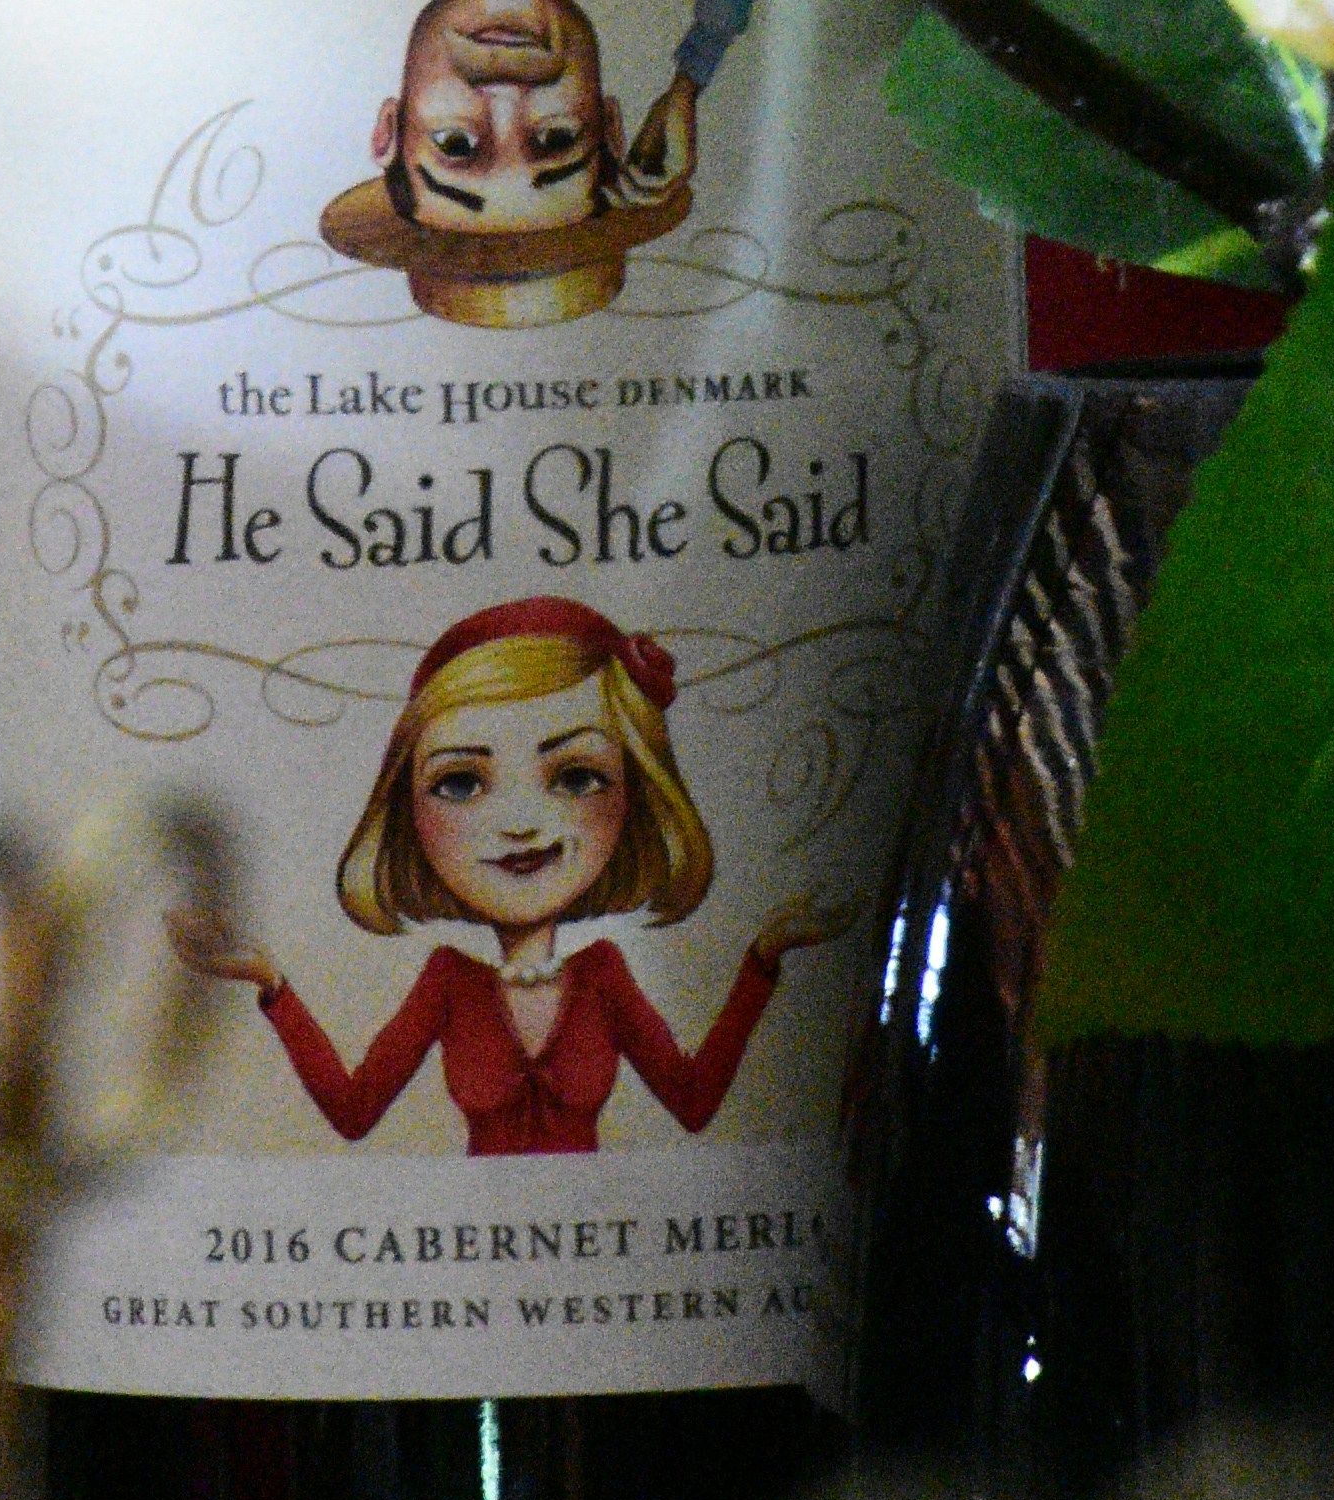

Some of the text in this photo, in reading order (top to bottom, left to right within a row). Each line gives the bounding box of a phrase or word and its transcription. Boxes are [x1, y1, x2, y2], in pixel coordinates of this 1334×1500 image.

[218, 370, 812, 424] the Lake House DENMARK
[165, 437, 869, 570] He Said She Said
[205, 1226, 312, 1265] 2016
[333, 1220, 638, 1265] CABERNET
[101, 1294, 224, 1330] GREAT
[240, 1297, 494, 1331] SOUTHERN
[517, 1289, 740, 1326] WESTERN
